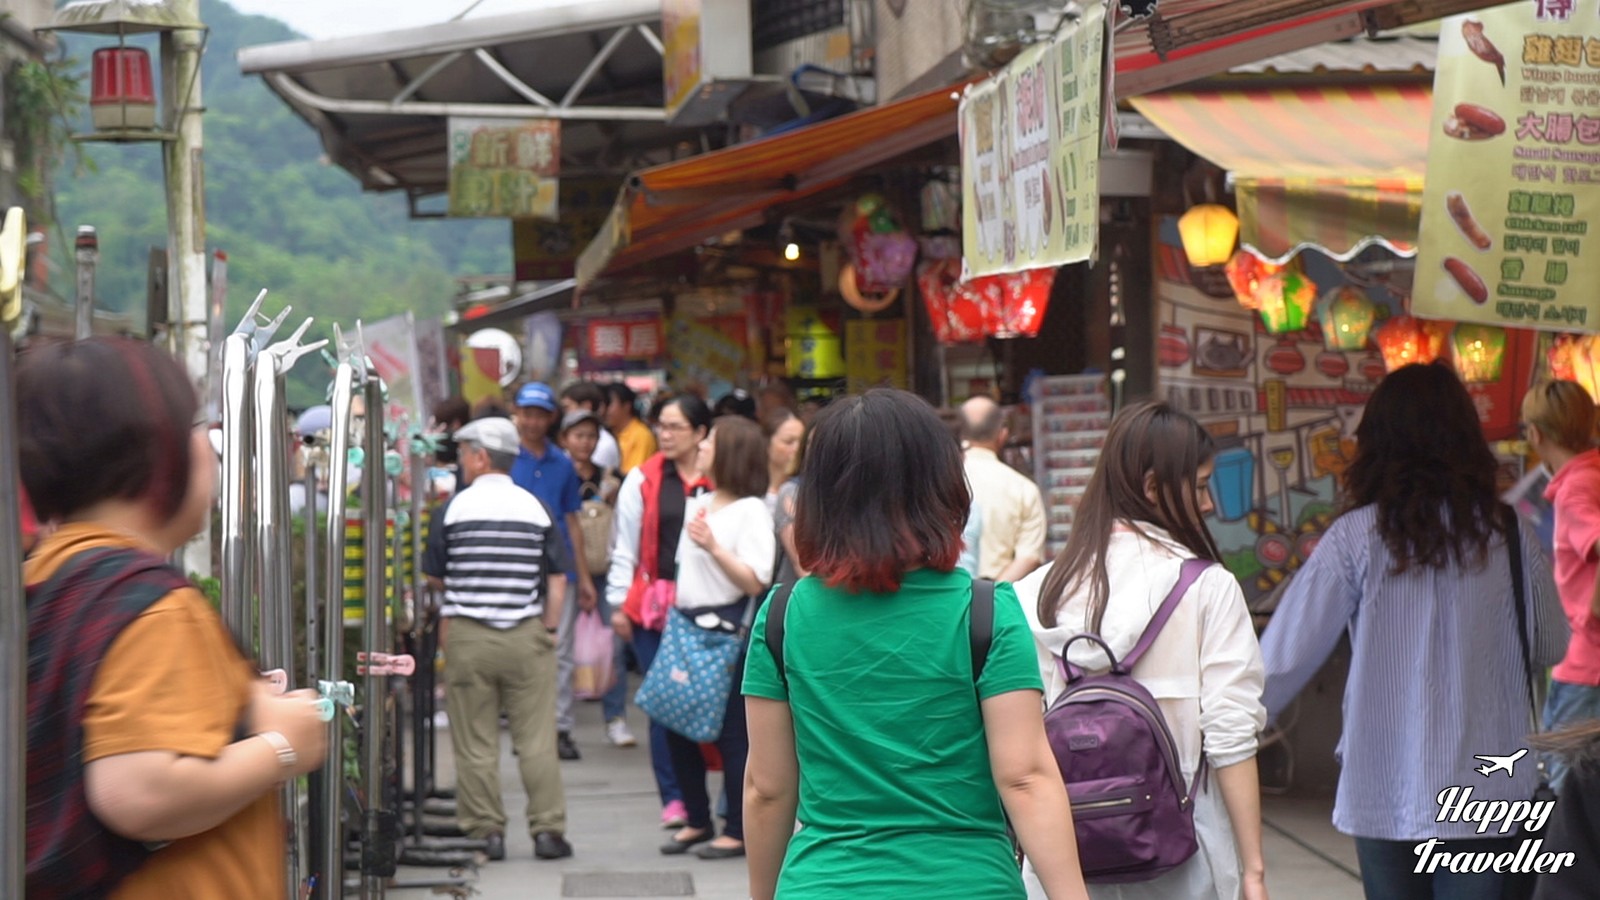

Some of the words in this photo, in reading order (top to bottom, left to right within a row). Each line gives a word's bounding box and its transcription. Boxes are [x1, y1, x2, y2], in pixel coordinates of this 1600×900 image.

[1513, 146, 1550, 159] Small
[1504, 216, 1561, 233] Chicken
[1562, 220, 1587, 235] roll
[1497, 282, 1556, 302] Sausage
